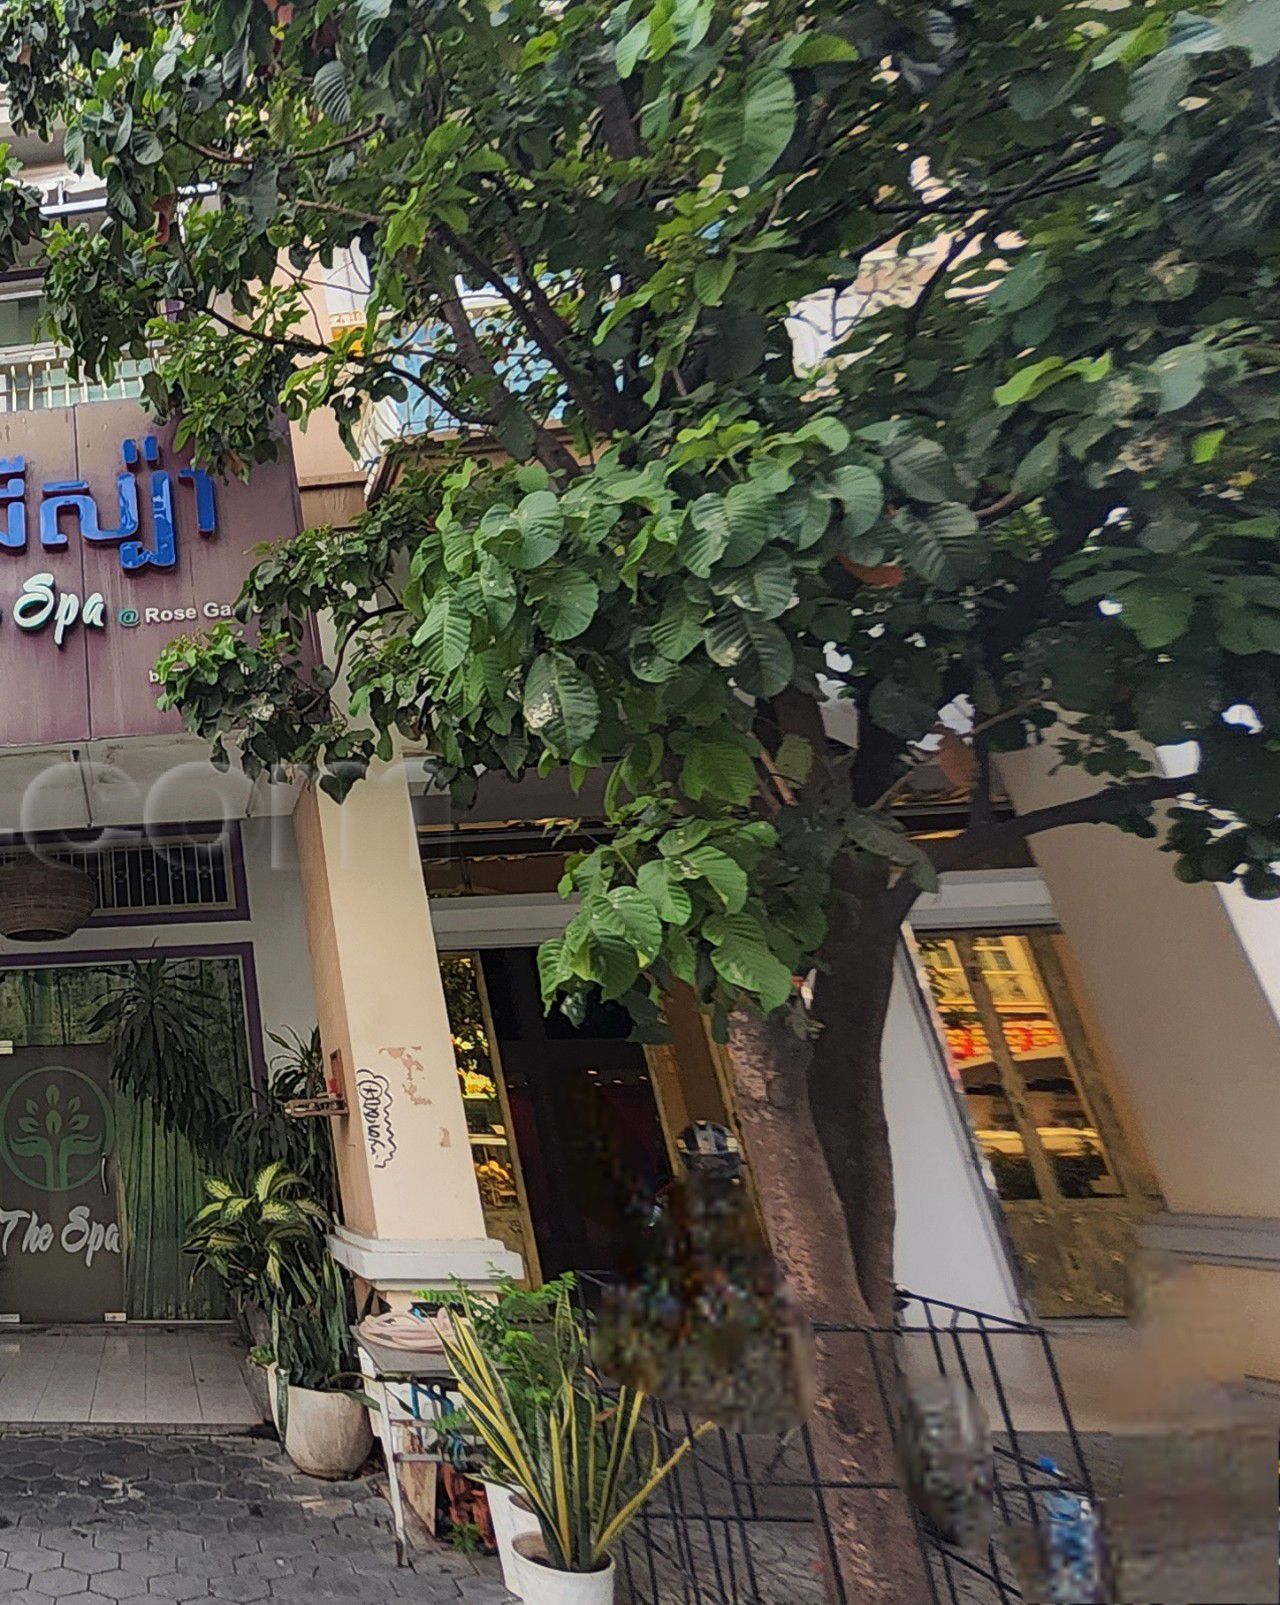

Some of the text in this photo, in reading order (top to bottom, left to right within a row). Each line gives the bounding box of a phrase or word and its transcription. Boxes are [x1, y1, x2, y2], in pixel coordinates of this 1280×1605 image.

[13, 571, 105, 650] Spa
[120, 608, 140, 628] @
[144, 603, 198, 624] Rose
[60, 1205, 121, 1268] Spa
